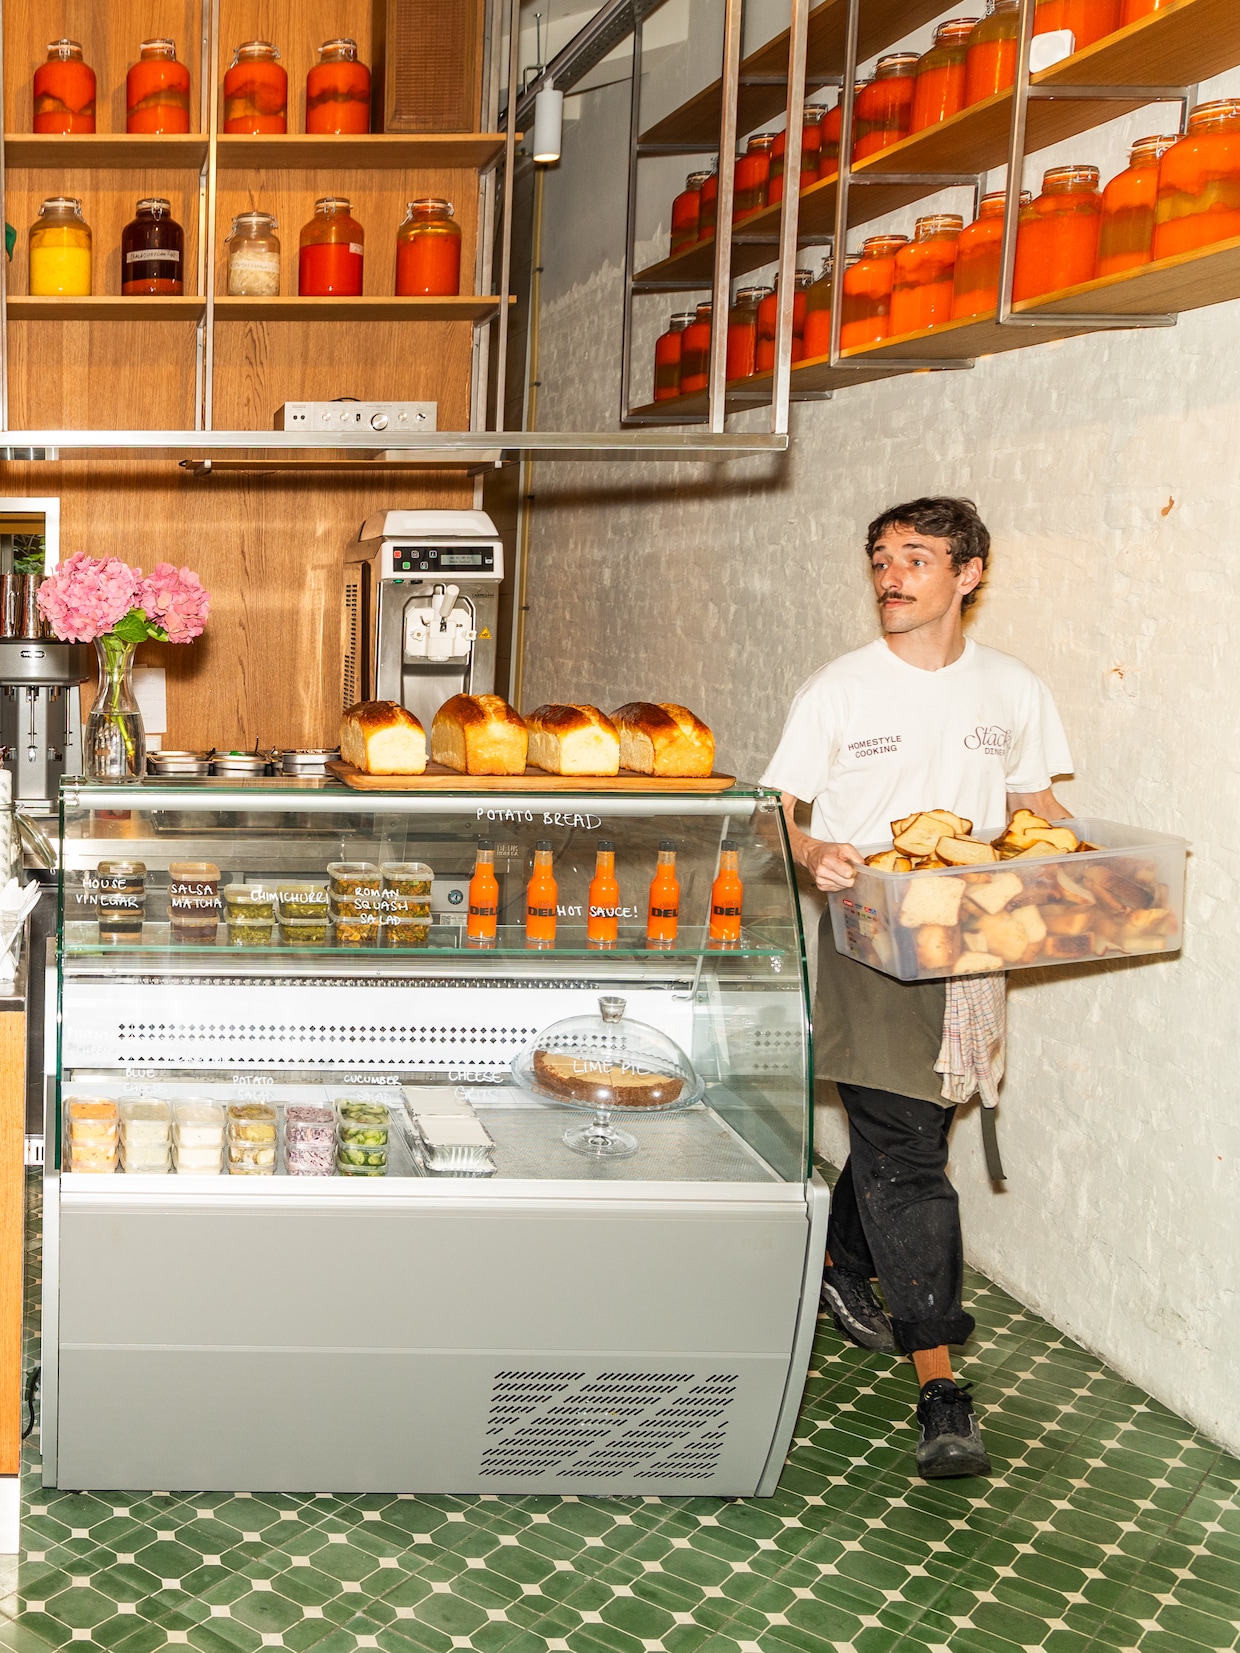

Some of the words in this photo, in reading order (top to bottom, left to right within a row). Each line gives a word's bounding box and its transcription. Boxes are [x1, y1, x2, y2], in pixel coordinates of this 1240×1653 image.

[847, 735, 902, 751] HOMESTYLE
[855, 745, 898, 759] COOKING
[476, 807, 534, 823] POTATO
[543, 812, 602, 830] BREAD
[82, 879, 127, 890] HOUSE
[171, 883, 214, 897] SALSA
[250, 889, 329, 905] CHIMICHURRI
[354, 887, 399, 900] ROMAN
[75, 894, 139, 909] VINEGAR
[171, 898, 223, 910] MATCHA
[354, 899, 409, 912] SQUASH
[556, 905, 583, 917] HOT
[589, 905, 638, 918] SAUCE!
[360, 913, 401, 926] SALAD
[125, 1067, 156, 1078] BLUE
[573, 1060, 614, 1074] LIME
[232, 1074, 274, 1086] POTATO
[343, 1074, 402, 1086] CUCUMBER
[448, 1071, 504, 1084] CHEESE
